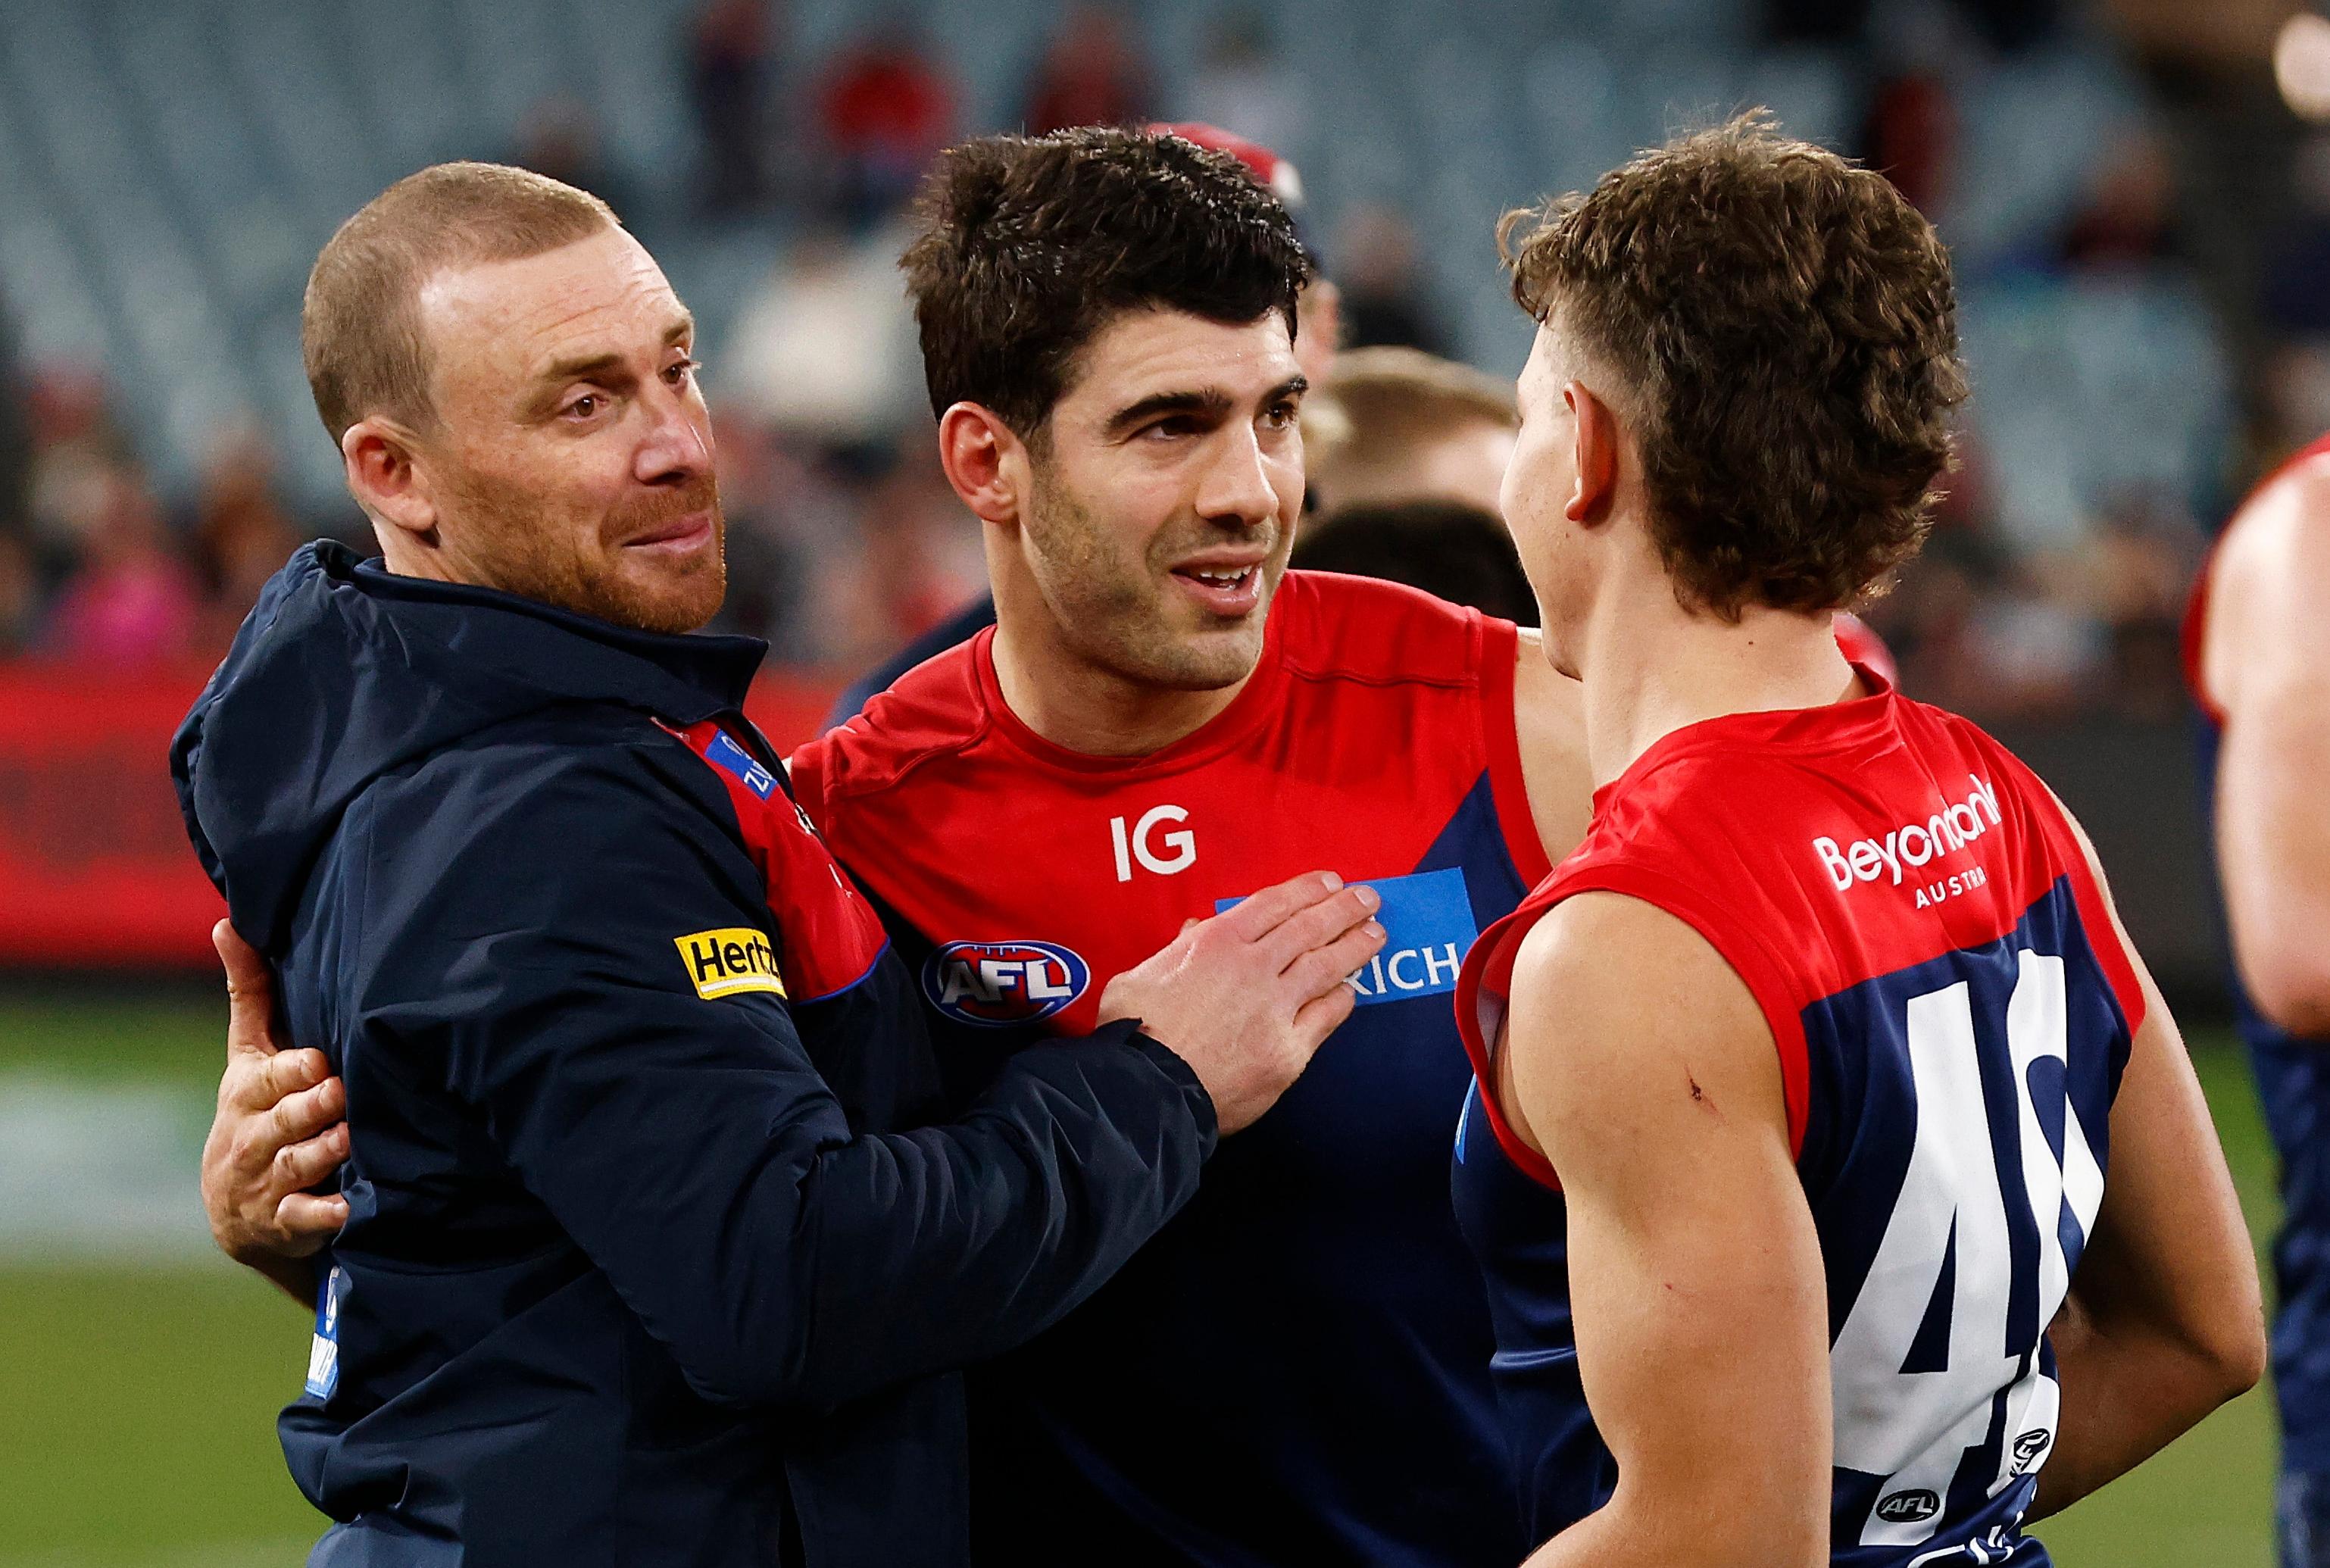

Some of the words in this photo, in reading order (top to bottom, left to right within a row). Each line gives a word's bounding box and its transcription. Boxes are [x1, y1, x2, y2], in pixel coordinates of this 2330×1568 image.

[1110, 804, 1197, 882] IG
[690, 935, 781, 982] Hertz
[940, 957, 1073, 1004] AFL
[1880, 1495, 1934, 1514] AFL
